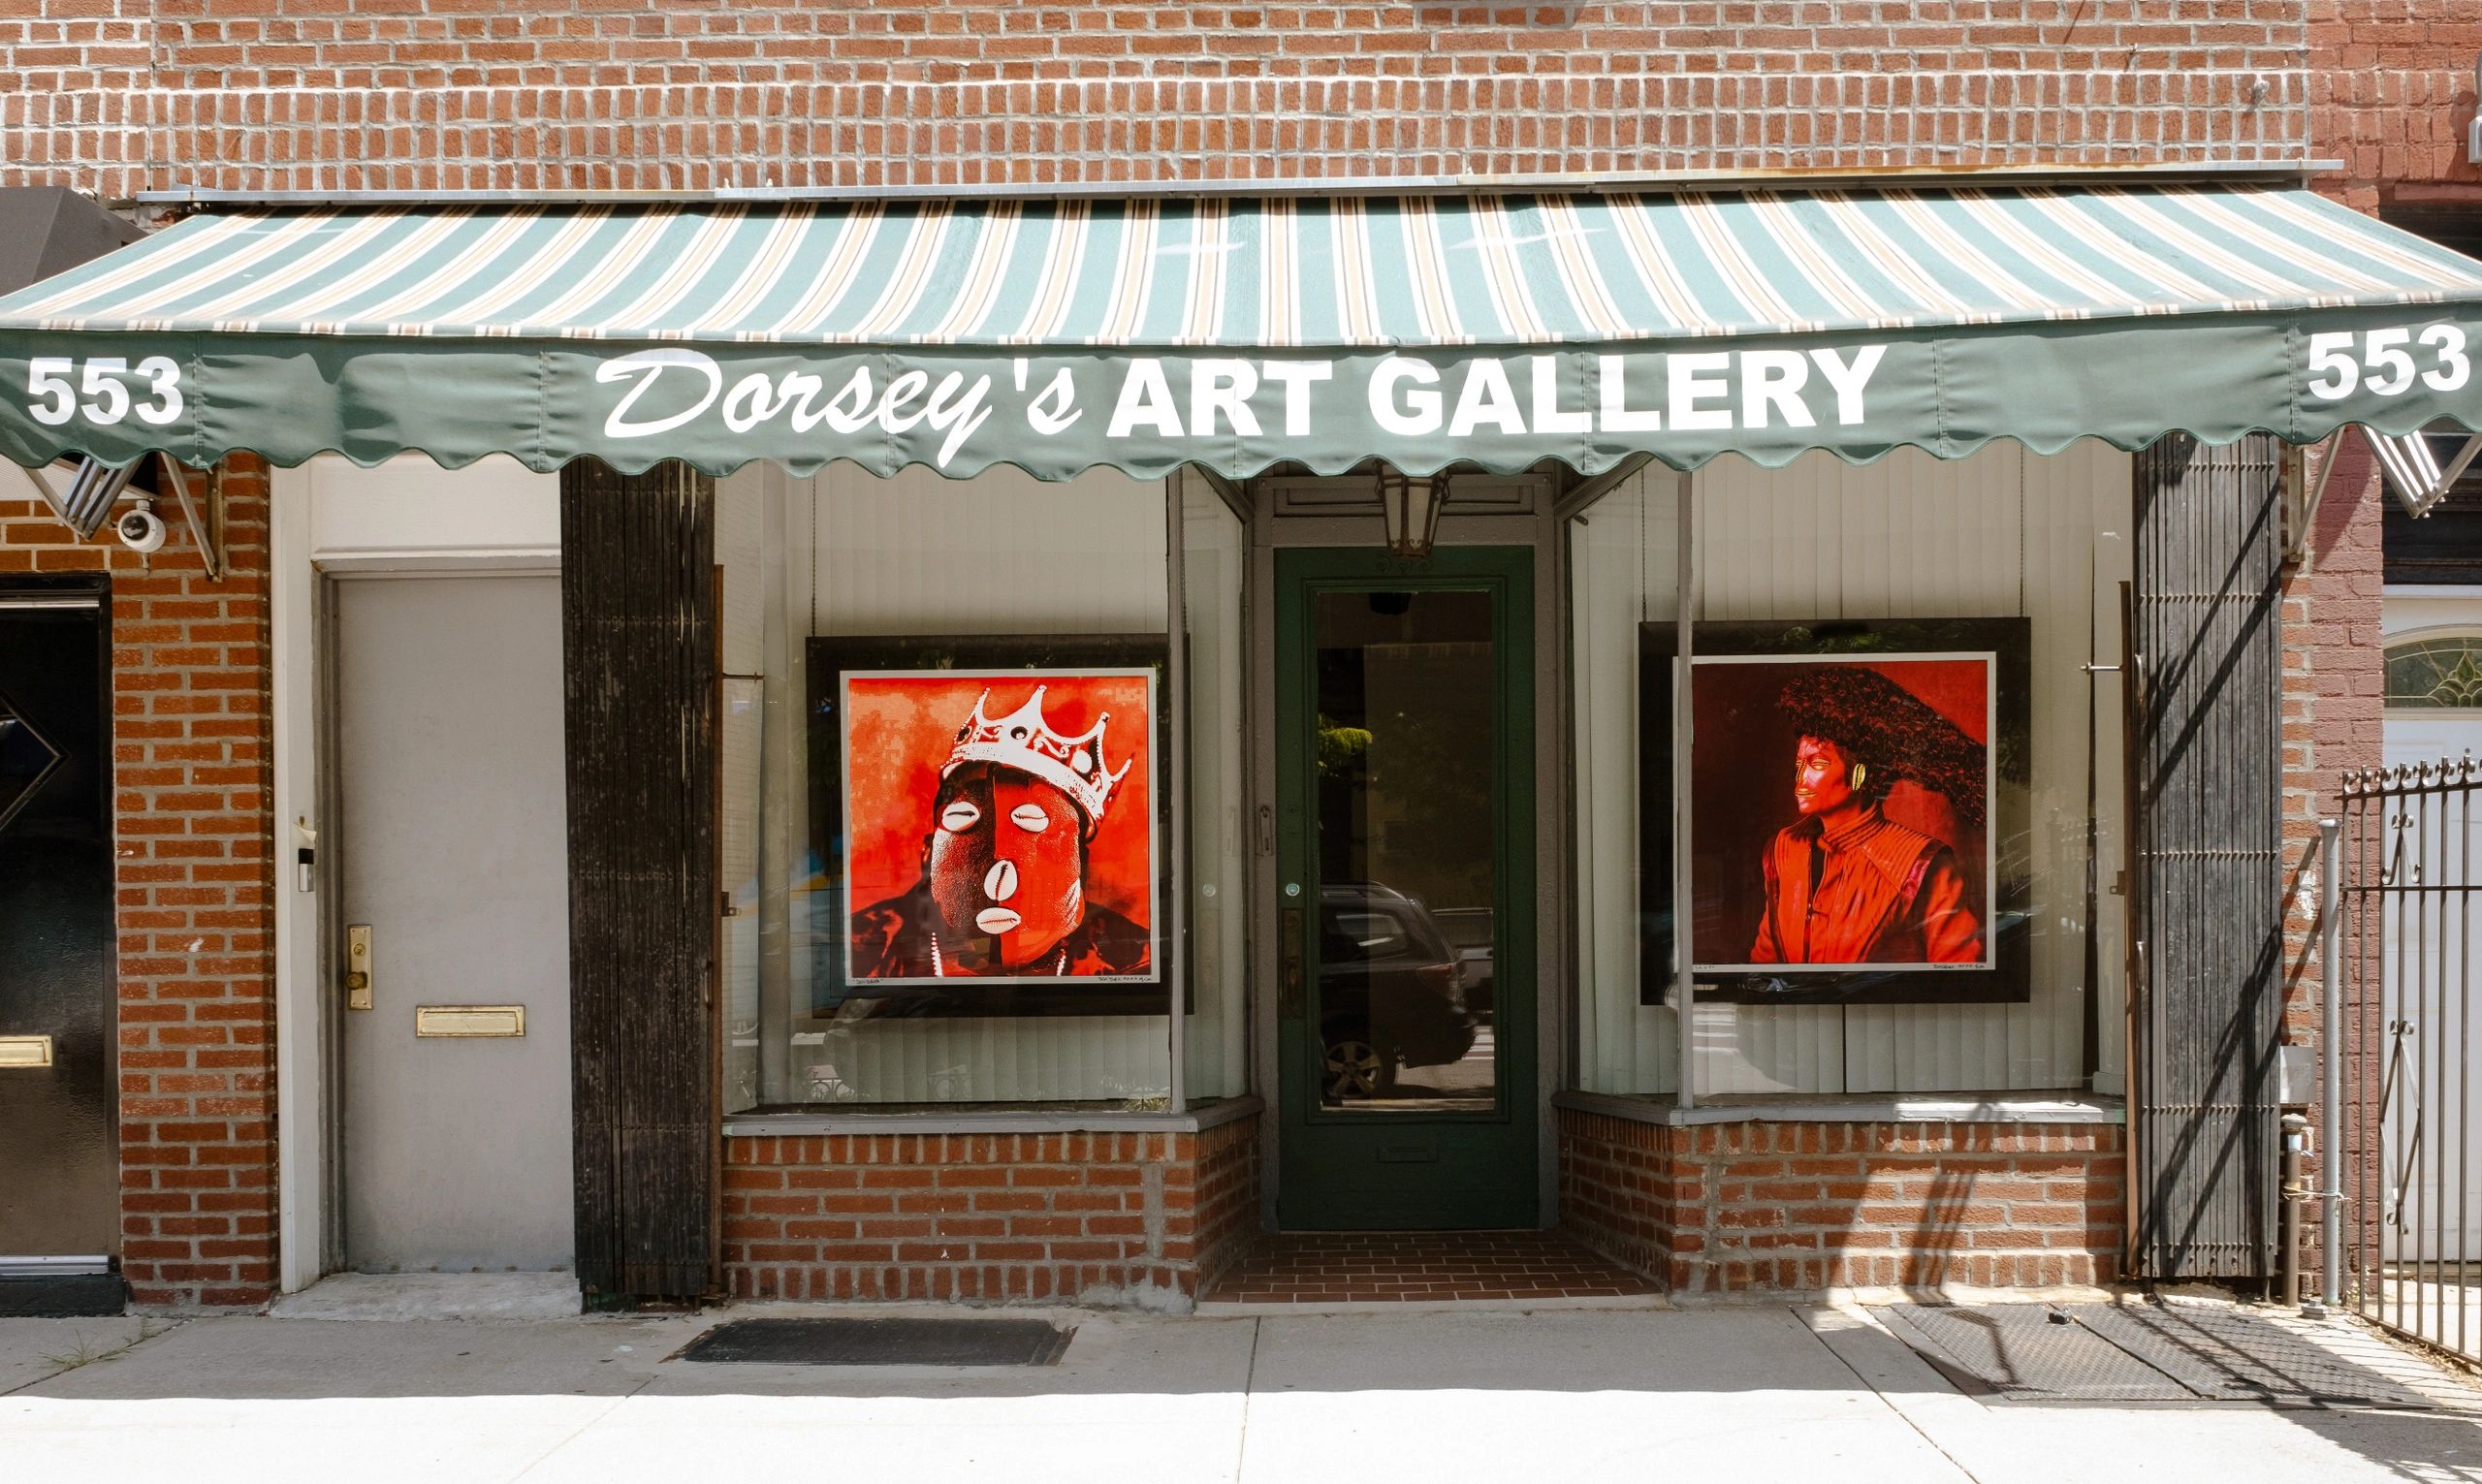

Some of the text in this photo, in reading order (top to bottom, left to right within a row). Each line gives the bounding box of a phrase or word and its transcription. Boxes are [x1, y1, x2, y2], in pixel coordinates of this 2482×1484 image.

[28, 356, 183, 425] 553
[2307, 324, 2470, 399] 553
[595, 345, 1887, 468] Dorsey's ART GALLERY
